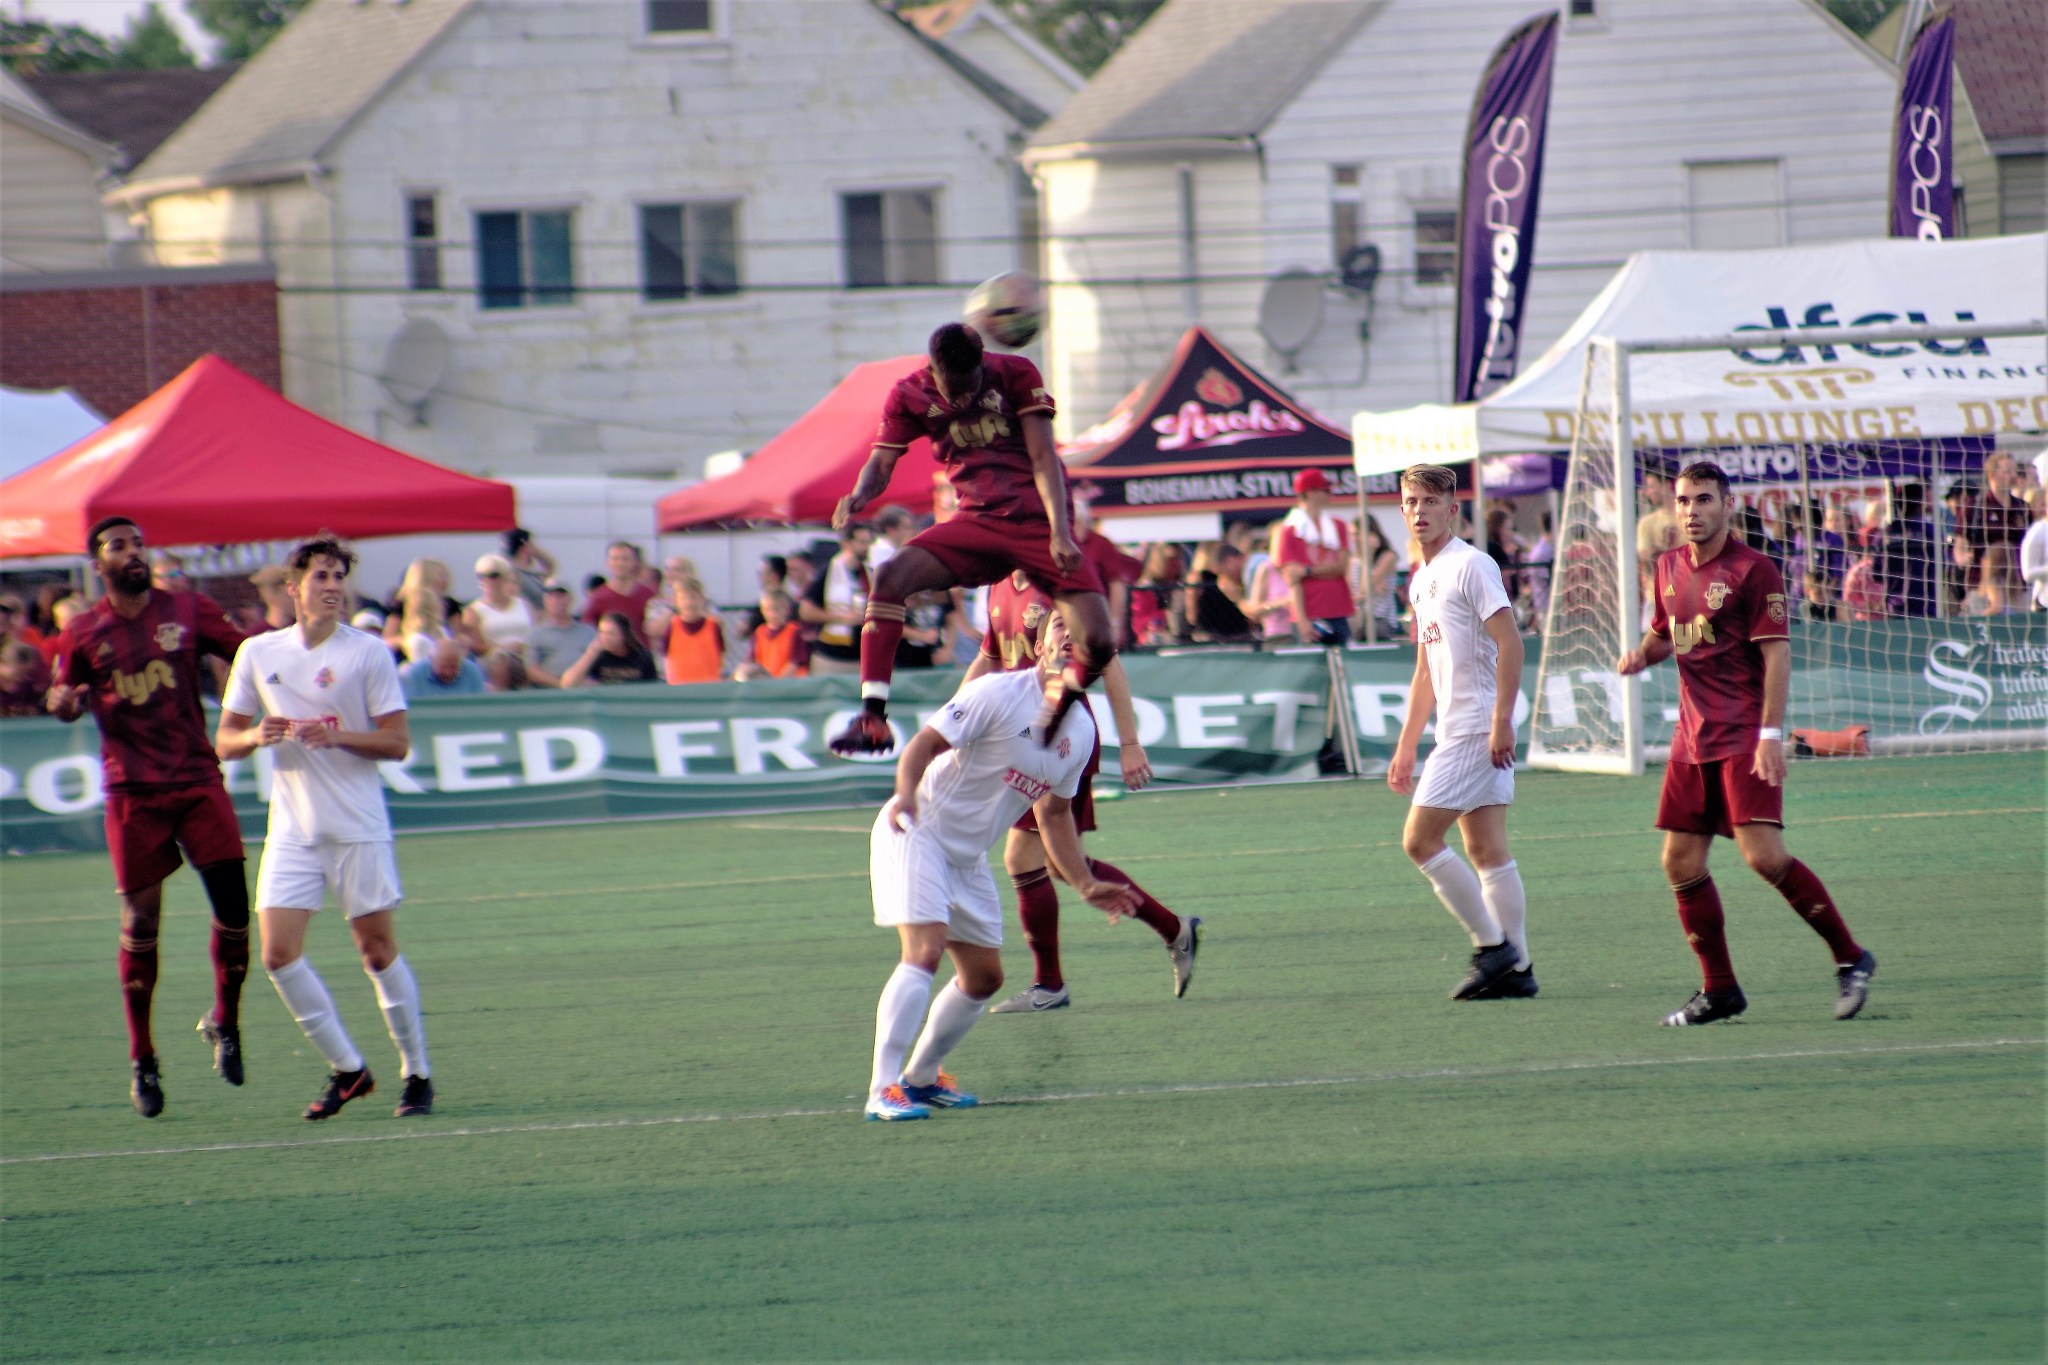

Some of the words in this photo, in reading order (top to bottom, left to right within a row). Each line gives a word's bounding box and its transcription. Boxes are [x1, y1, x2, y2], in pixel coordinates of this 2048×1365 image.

[1729, 302, 1991, 365] dfcu
[1701, 405, 1921, 445] LOUNGE
[1681, 443, 1866, 477] etroCS
[1125, 470, 1302, 504] BOHEMIAN-STYL
[112, 659, 176, 706] lyft
[650, 708, 936, 778] FRO
